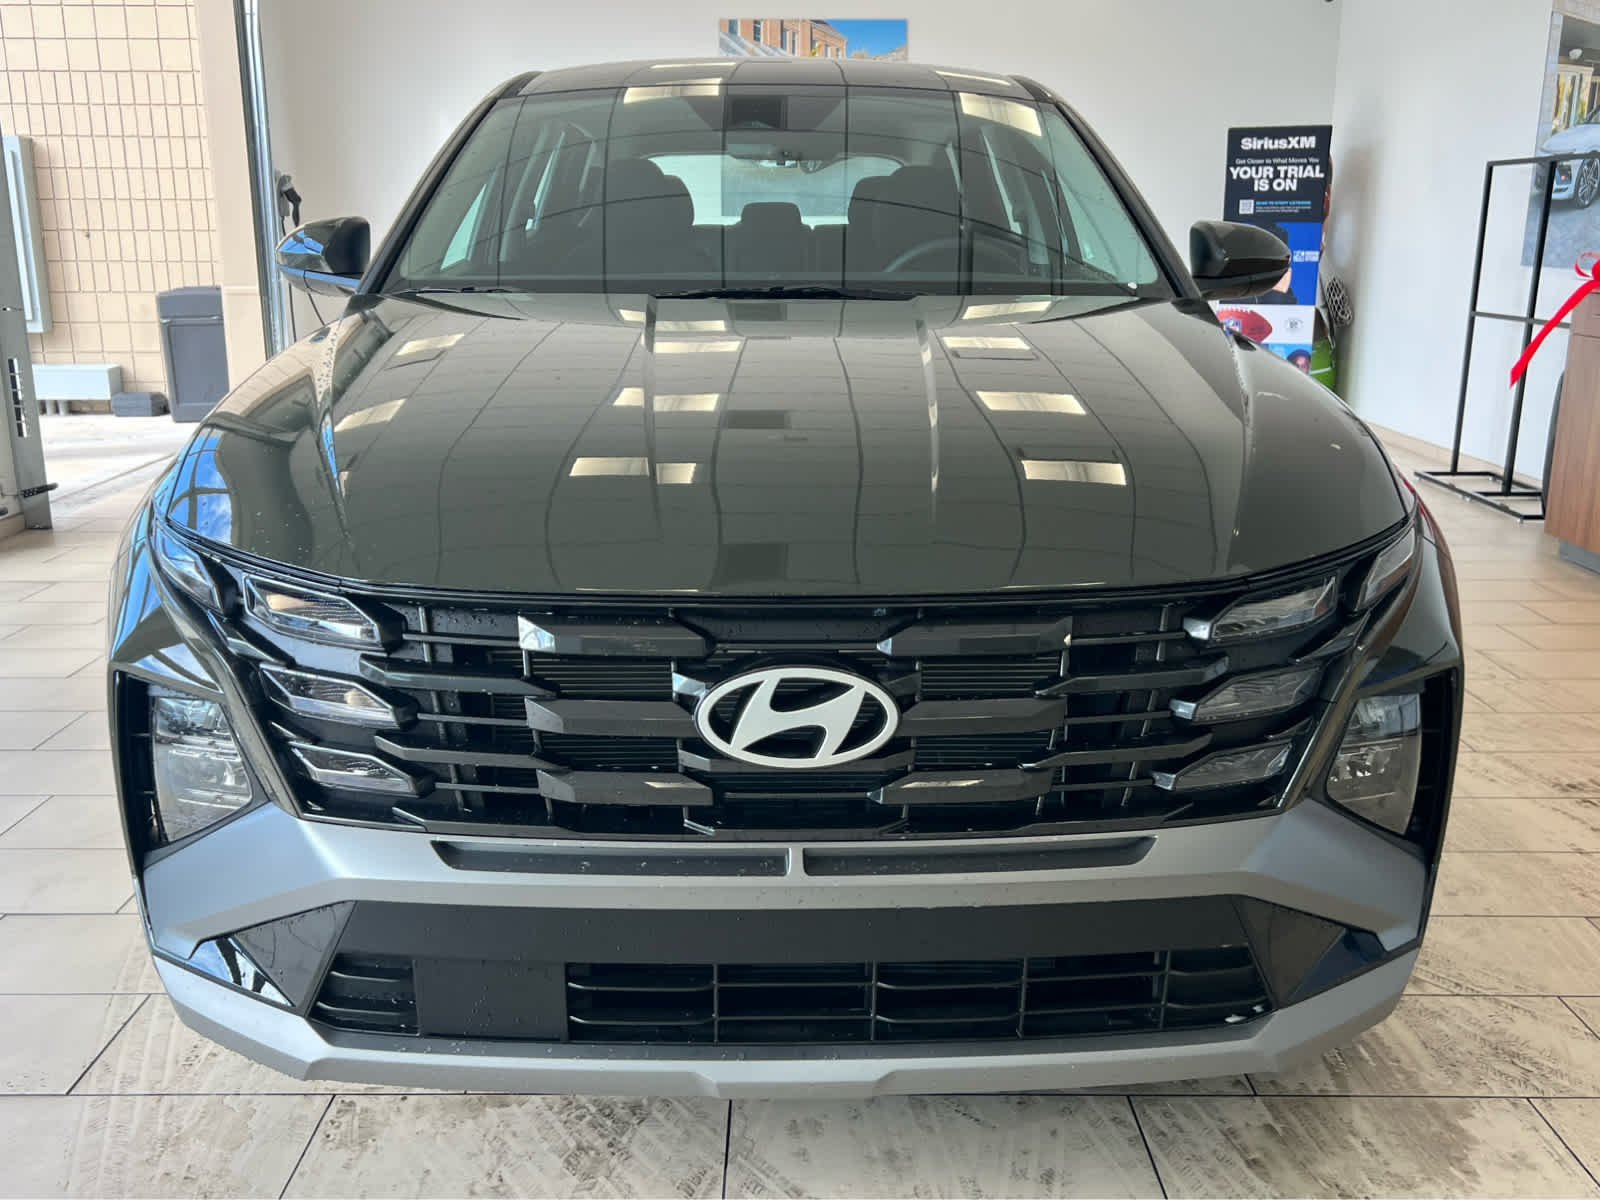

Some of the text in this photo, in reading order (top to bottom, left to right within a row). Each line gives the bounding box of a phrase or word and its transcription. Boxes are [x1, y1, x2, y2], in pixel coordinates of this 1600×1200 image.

[1241, 136, 1316, 150] SiriusXM
[1229, 165, 1325, 179] YOUR TRIAL
[1254, 179, 1298, 192] IS ON
